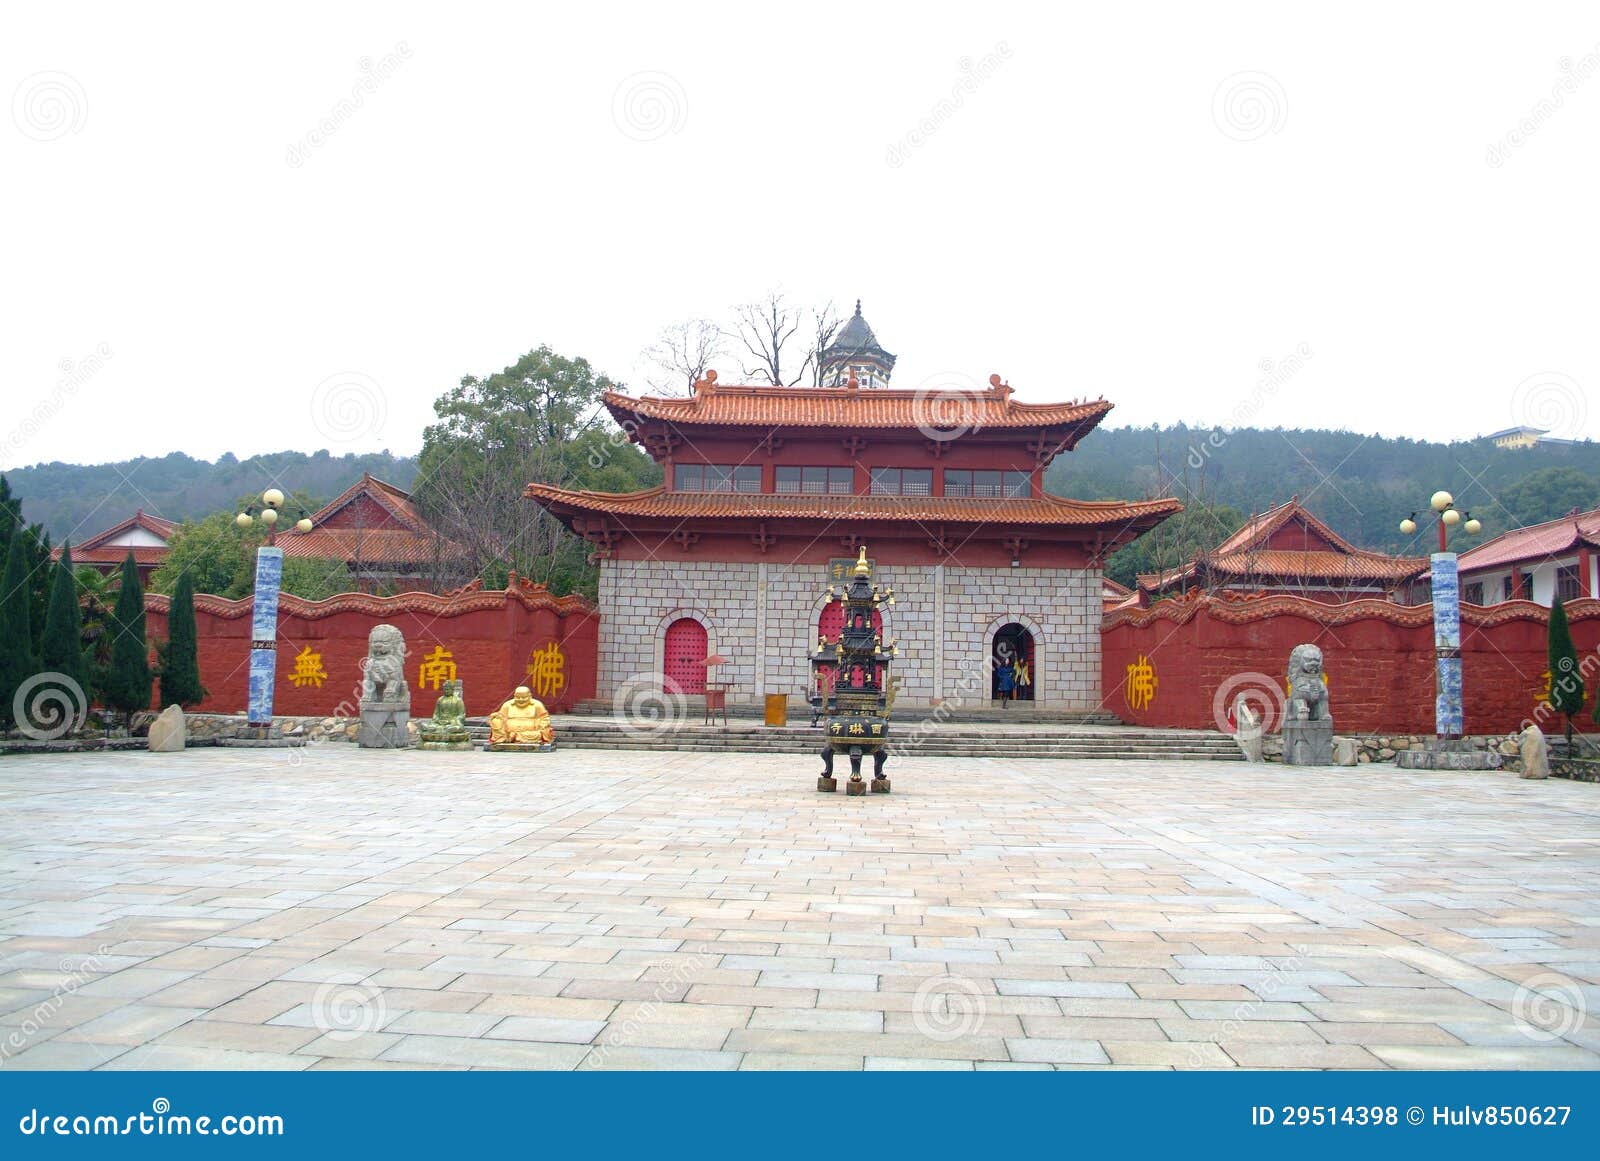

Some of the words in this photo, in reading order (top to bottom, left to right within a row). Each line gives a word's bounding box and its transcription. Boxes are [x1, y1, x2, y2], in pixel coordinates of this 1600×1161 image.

[288, 644, 329, 689] 無
[418, 645, 456, 690] 南
[527, 641, 564, 697] 佛
[1127, 654, 1159, 711] 佛
